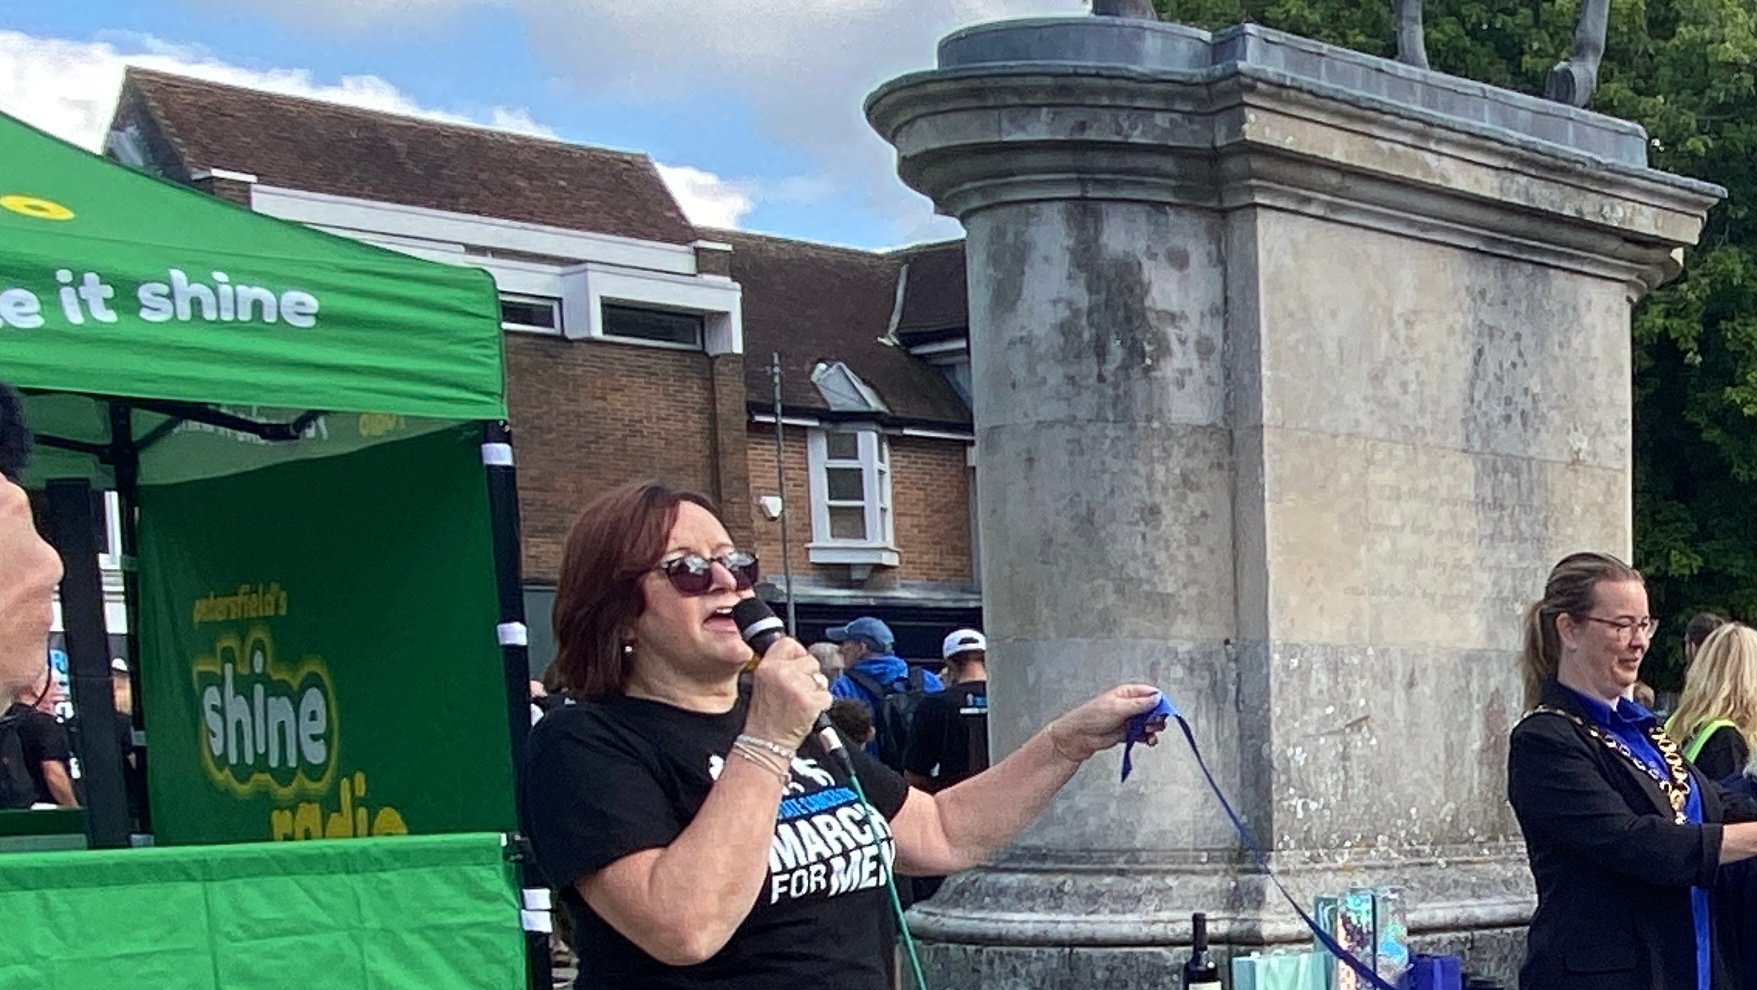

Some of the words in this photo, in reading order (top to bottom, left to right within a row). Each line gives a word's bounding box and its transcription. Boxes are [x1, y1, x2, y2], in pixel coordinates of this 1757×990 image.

[0, 287, 45, 329] e
[55, 268, 118, 325] it
[137, 267, 320, 328] shine
[203, 649, 327, 769] shine
[770, 863, 827, 905] FOR
